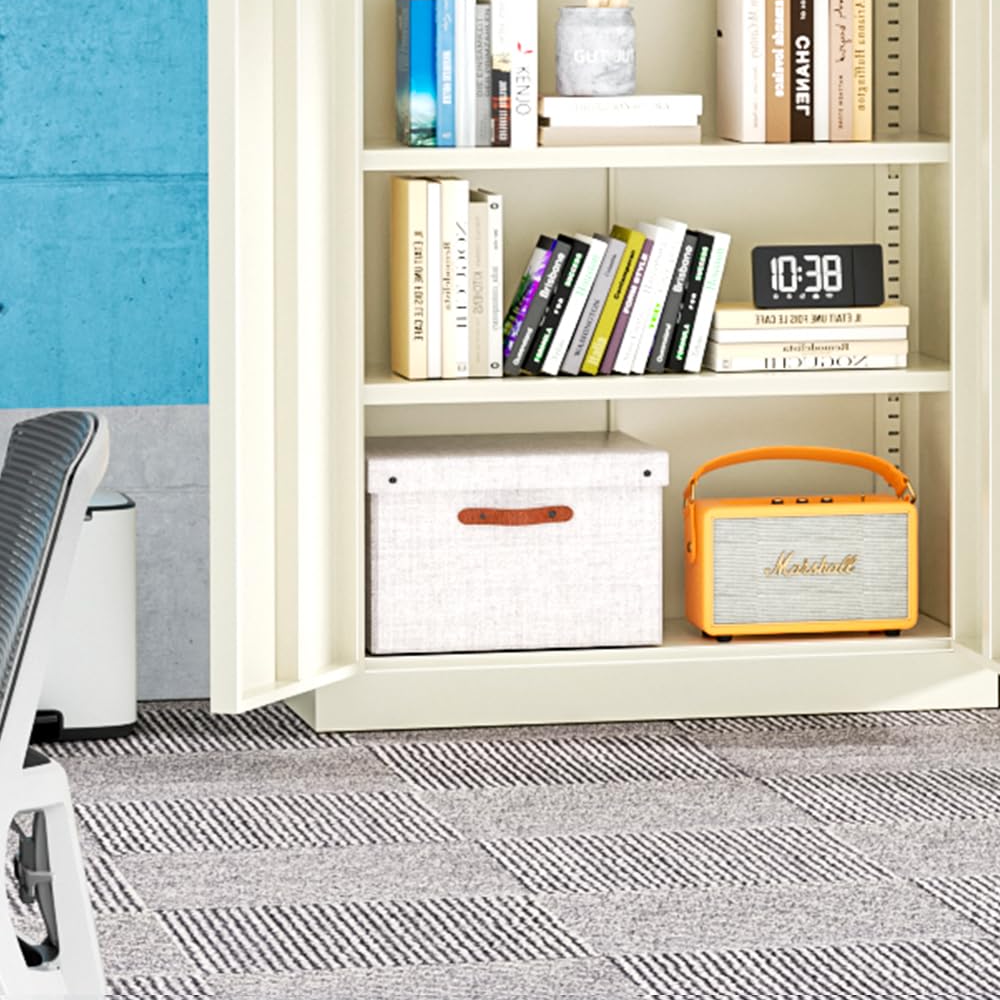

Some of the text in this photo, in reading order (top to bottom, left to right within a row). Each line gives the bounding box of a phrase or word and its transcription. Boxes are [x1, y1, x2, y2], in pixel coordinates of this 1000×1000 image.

[515, 66, 532, 117] KENJO
[538, 252, 566, 299] Brisbane
[633, 252, 649, 285] STYLE
[671, 245, 693, 293] Brisbane
[770, 254, 842, 293] 10:38
[763, 550, 859, 578] Marshall
